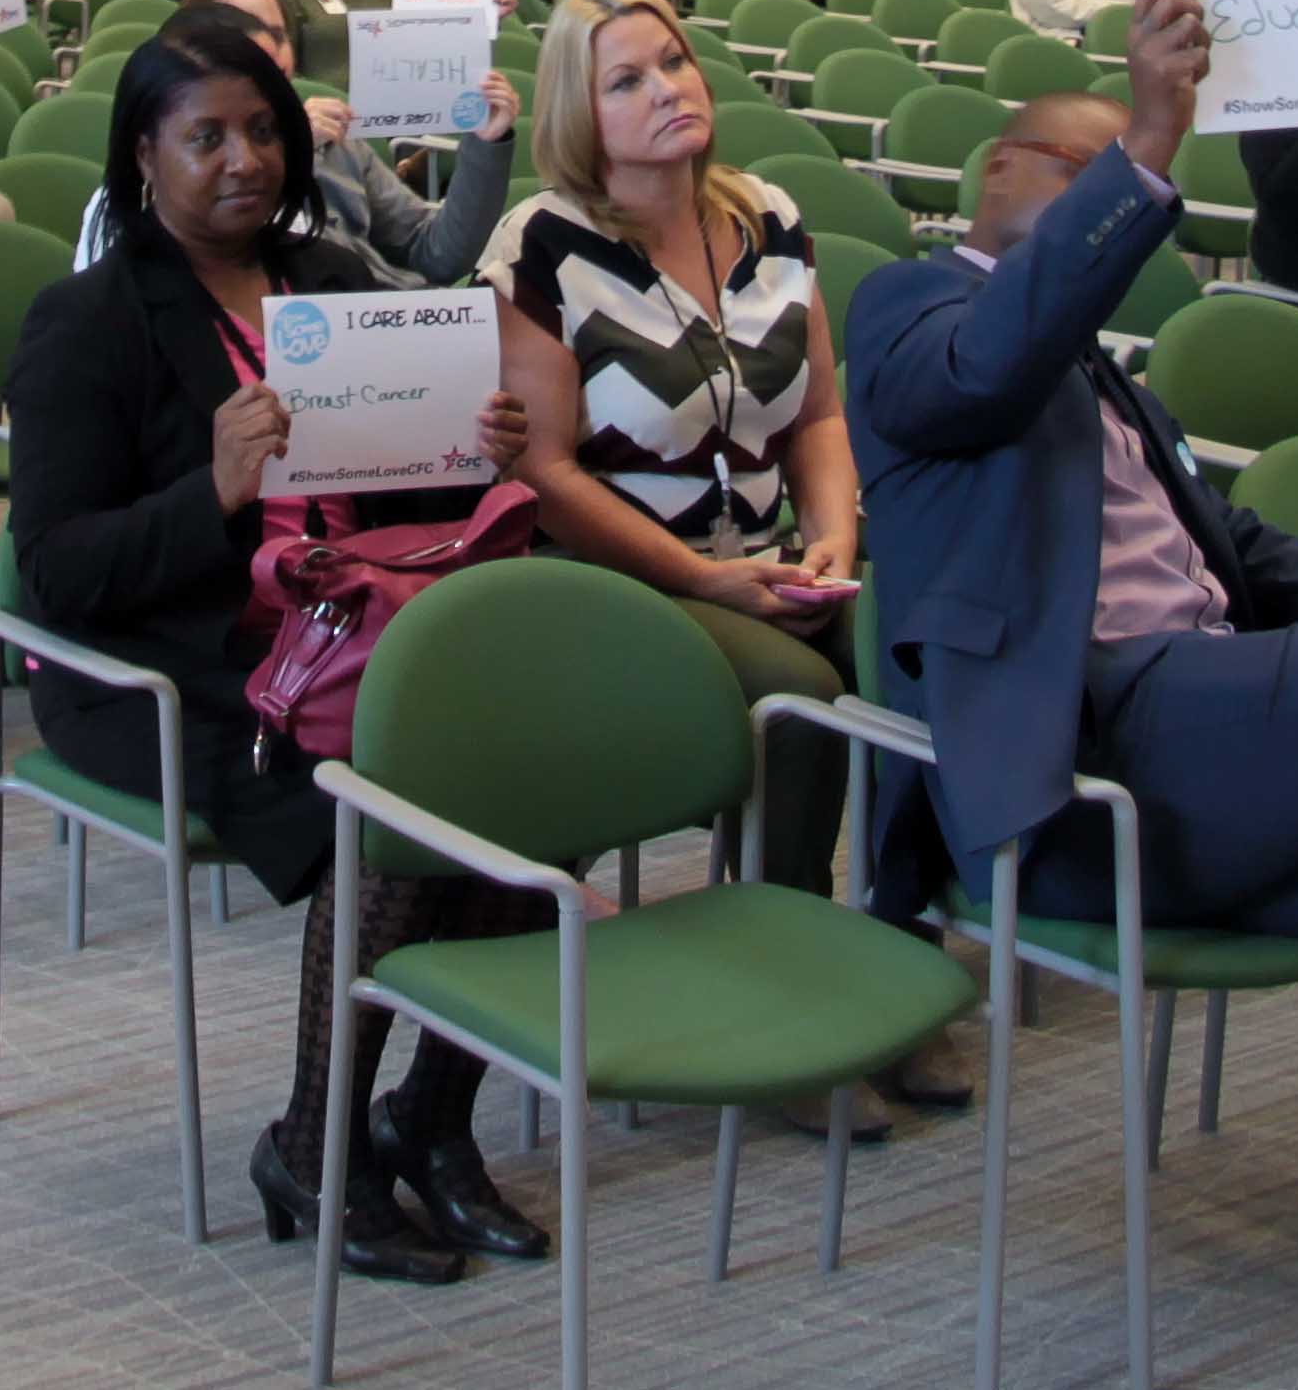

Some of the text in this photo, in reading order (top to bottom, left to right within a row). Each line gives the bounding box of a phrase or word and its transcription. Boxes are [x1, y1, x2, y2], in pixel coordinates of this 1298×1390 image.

[372, 55, 466, 84] HEALTH
[345, 311, 354, 330] I
[359, 310, 407, 330] CARE
[283, 385, 431, 414] Breast Cancer
[287, 462, 435, 483] #ShowSomeLoveCFC
